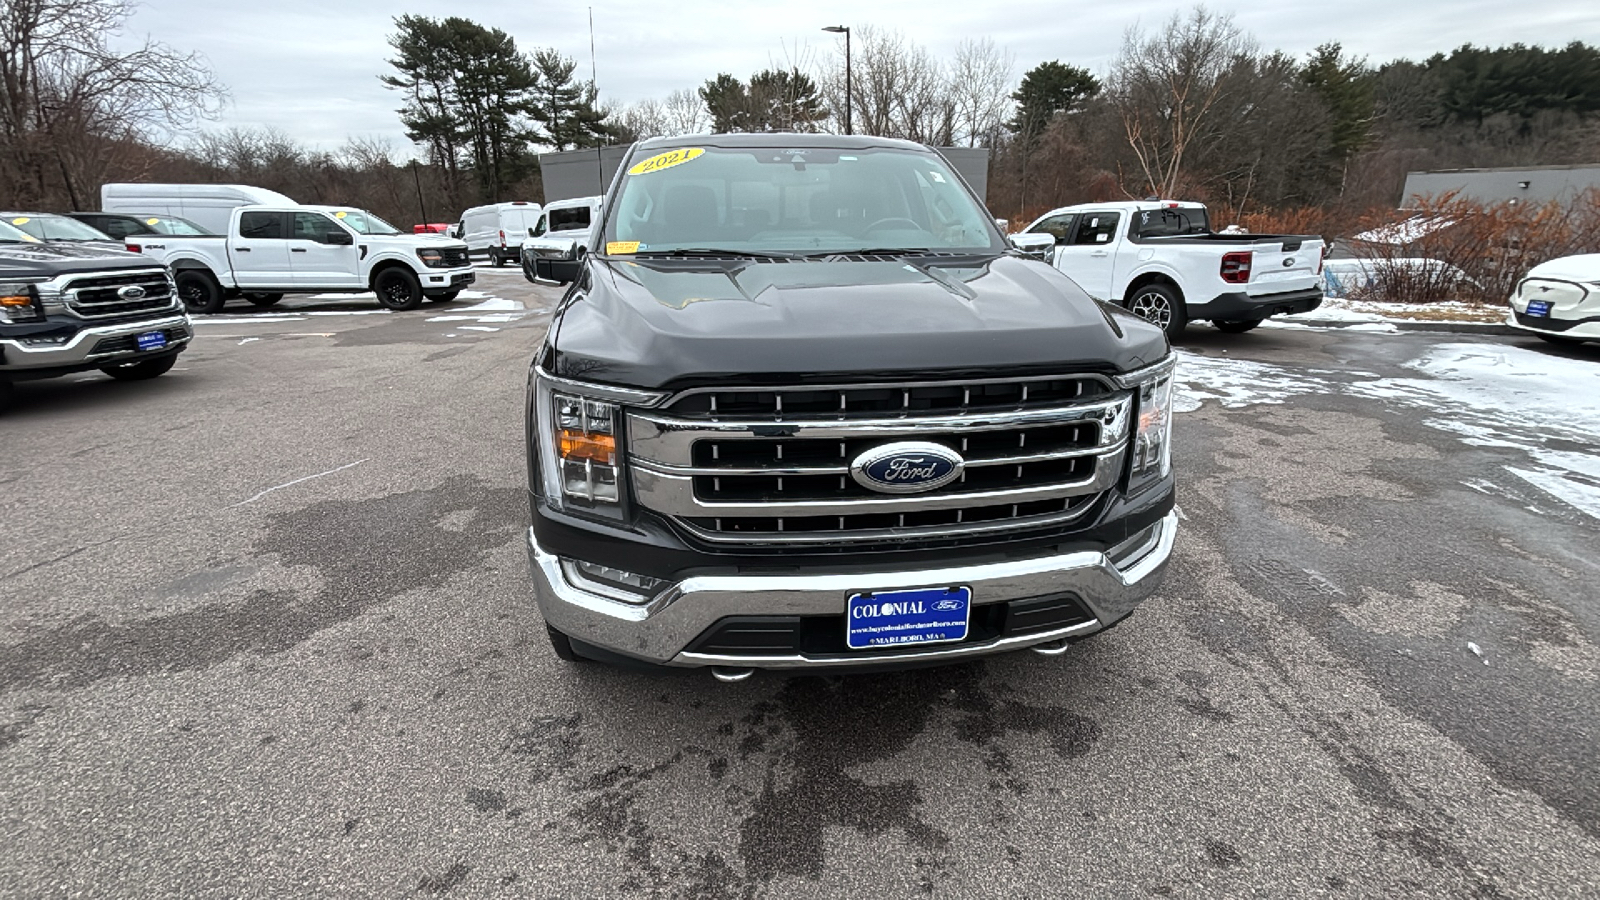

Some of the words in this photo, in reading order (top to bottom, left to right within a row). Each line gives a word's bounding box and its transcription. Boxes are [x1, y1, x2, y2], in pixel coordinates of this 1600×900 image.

[642, 149, 691, 173] 2021
[884, 458, 937, 480] Ford
[853, 601, 926, 618] COLONIAL
[937, 600, 957, 609] Ford
[925, 632, 940, 641] MA
